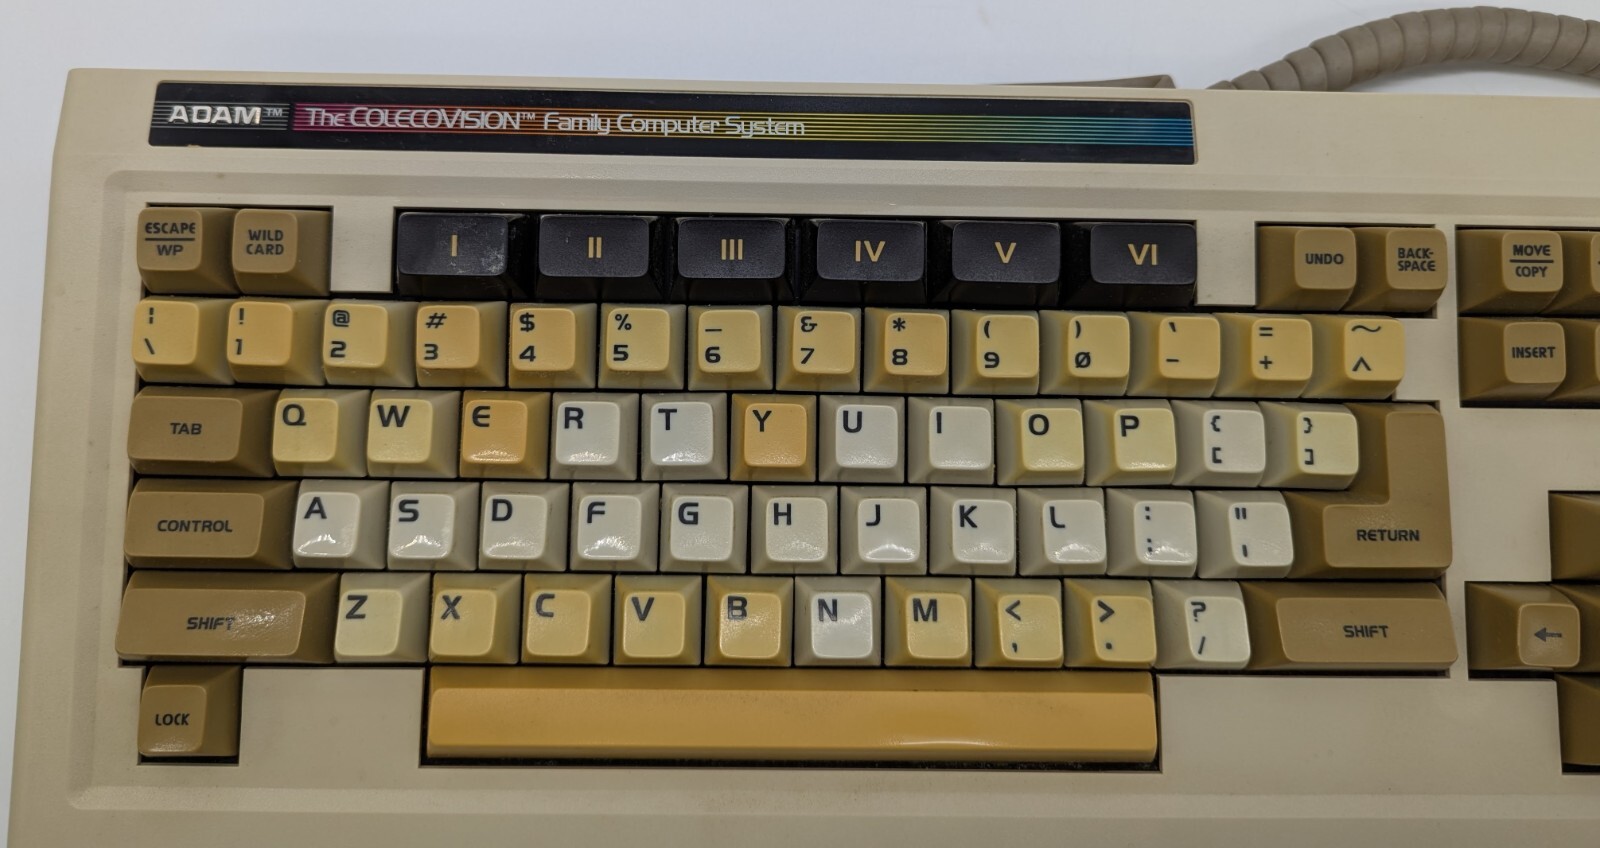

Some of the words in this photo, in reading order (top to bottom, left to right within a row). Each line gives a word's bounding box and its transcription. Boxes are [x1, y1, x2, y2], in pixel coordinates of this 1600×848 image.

[306, 107, 346, 126] The
[544, 112, 612, 135] Family
[617, 114, 720, 136] Computer
[725, 116, 805, 138] System
[145, 223, 195, 233] ESCAPE
[248, 230, 283, 241] WILD
[157, 245, 183, 255] WP
[246, 243, 284, 255] CARD
[589, 237, 601, 258] II
[722, 239, 742, 260] III
[856, 241, 885, 261] IV
[995, 242, 1016, 263] V
[1128, 244, 1157, 265] VI
[1397, 248, 1434, 259] BACK-
[1513, 245, 1550, 256] MOVE
[1306, 254, 1344, 264] UNDO
[1397, 260, 1435, 272] SPACE
[1516, 266, 1547, 277] COPY
[240, 308, 244, 324] !
[333, 310, 350, 327] @
[426, 313, 447, 328] #
[520, 313, 534, 332] $
[615, 314, 631, 330] %
[801, 316, 817, 332] &
[984, 321, 990, 338] (
[1076, 321, 1081, 338] )
[1260, 327, 1273, 336] =
[236, 339, 242, 355] 1
[331, 341, 346, 357] 2
[424, 344, 438, 360] 3
[520, 346, 535, 361] 4
[614, 345, 628, 361] 5
[705, 347, 720, 363] 6
[1512, 347, 1555, 358] INSERT
[801, 348, 814, 364] 7
[892, 349, 907, 365] 8
[984, 352, 999, 368] 9
[1260, 356, 1272, 369] +
[283, 404, 306, 426] Q
[377, 405, 410, 427] W
[472, 406, 490, 427] E
[565, 407, 583, 429] R
[658, 409, 677, 430] T
[753, 410, 772, 432] Y
[843, 411, 862, 433] U
[171, 423, 202, 435] TAB
[1029, 414, 1049, 435] O
[1121, 415, 1139, 437] P
[1211, 416, 1220, 432] {
[1304, 418, 1312, 433] }
[1212, 447, 1222, 463] [
[1305, 449, 1314, 465] ]
[304, 497, 326, 519] A
[399, 500, 418, 522] S
[492, 499, 512, 521] D
[587, 502, 605, 523] F
[678, 502, 698, 525] G
[774, 503, 791, 525] H
[866, 505, 880, 526] J
[960, 505, 977, 528] K
[158, 520, 232, 532] CONTROL
[1050, 507, 1065, 528] L
[1357, 530, 1419, 541] RETURN
[346, 595, 367, 619] Z
[441, 595, 461, 619] X
[536, 594, 555, 617] C
[632, 597, 654, 621] V
[728, 596, 747, 619] B
[818, 599, 837, 621] N
[913, 599, 937, 622] M
[1006, 600, 1021, 621] <
[1098, 600, 1114, 622] >
[1191, 602, 1206, 621] ?
[187, 617, 234, 630] SHIFT
[1343, 626, 1388, 637] SHIFT
[1198, 637, 1205, 654] /
[156, 714, 189, 726] LOCK
